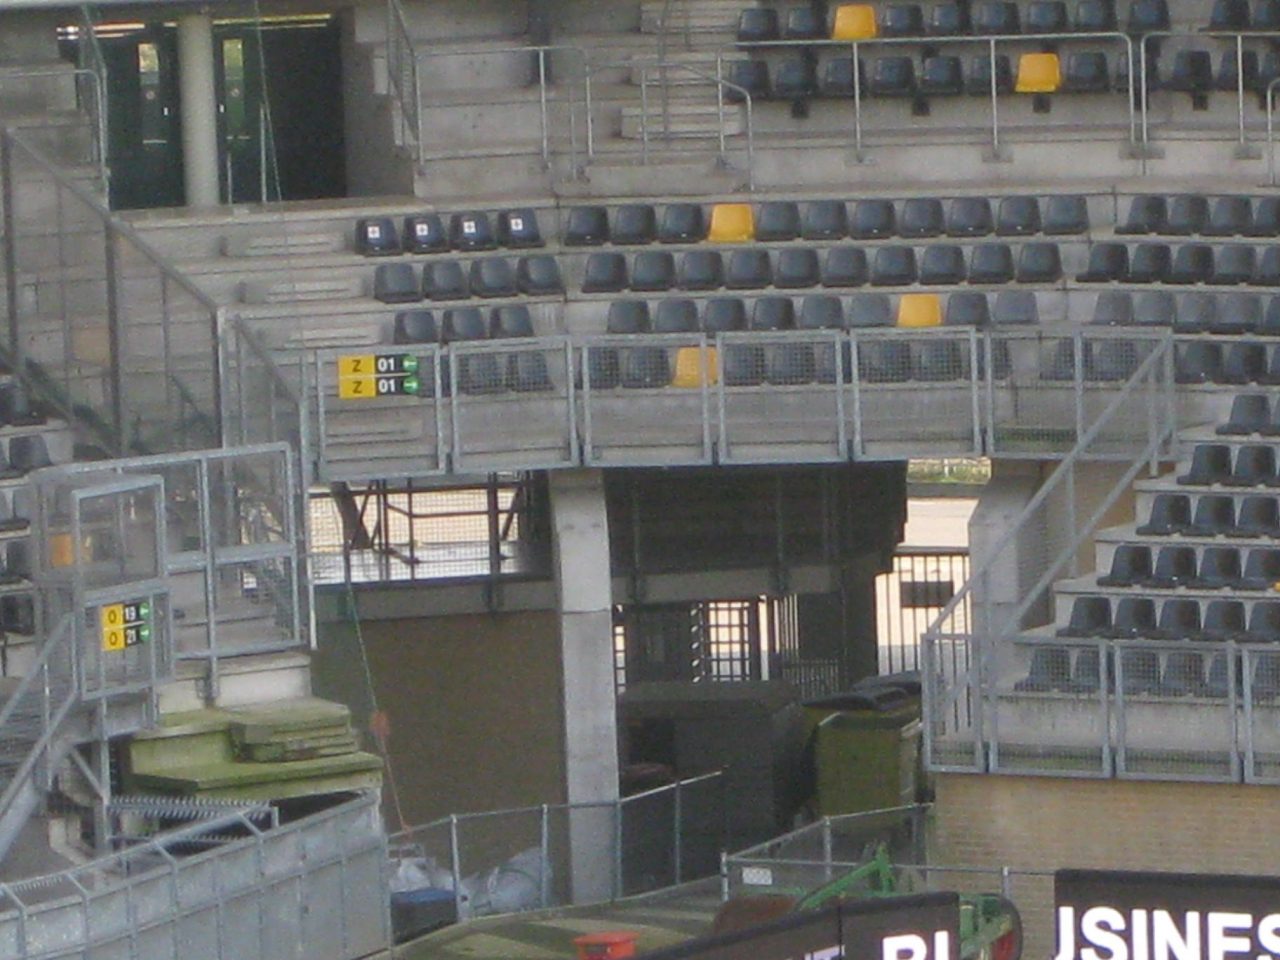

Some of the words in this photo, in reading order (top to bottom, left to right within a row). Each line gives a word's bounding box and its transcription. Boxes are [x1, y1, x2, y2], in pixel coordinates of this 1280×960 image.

[352, 359, 362, 373] Z
[377, 357, 395, 372] 01
[352, 381, 363, 394] Z
[378, 379, 396, 393] 01
